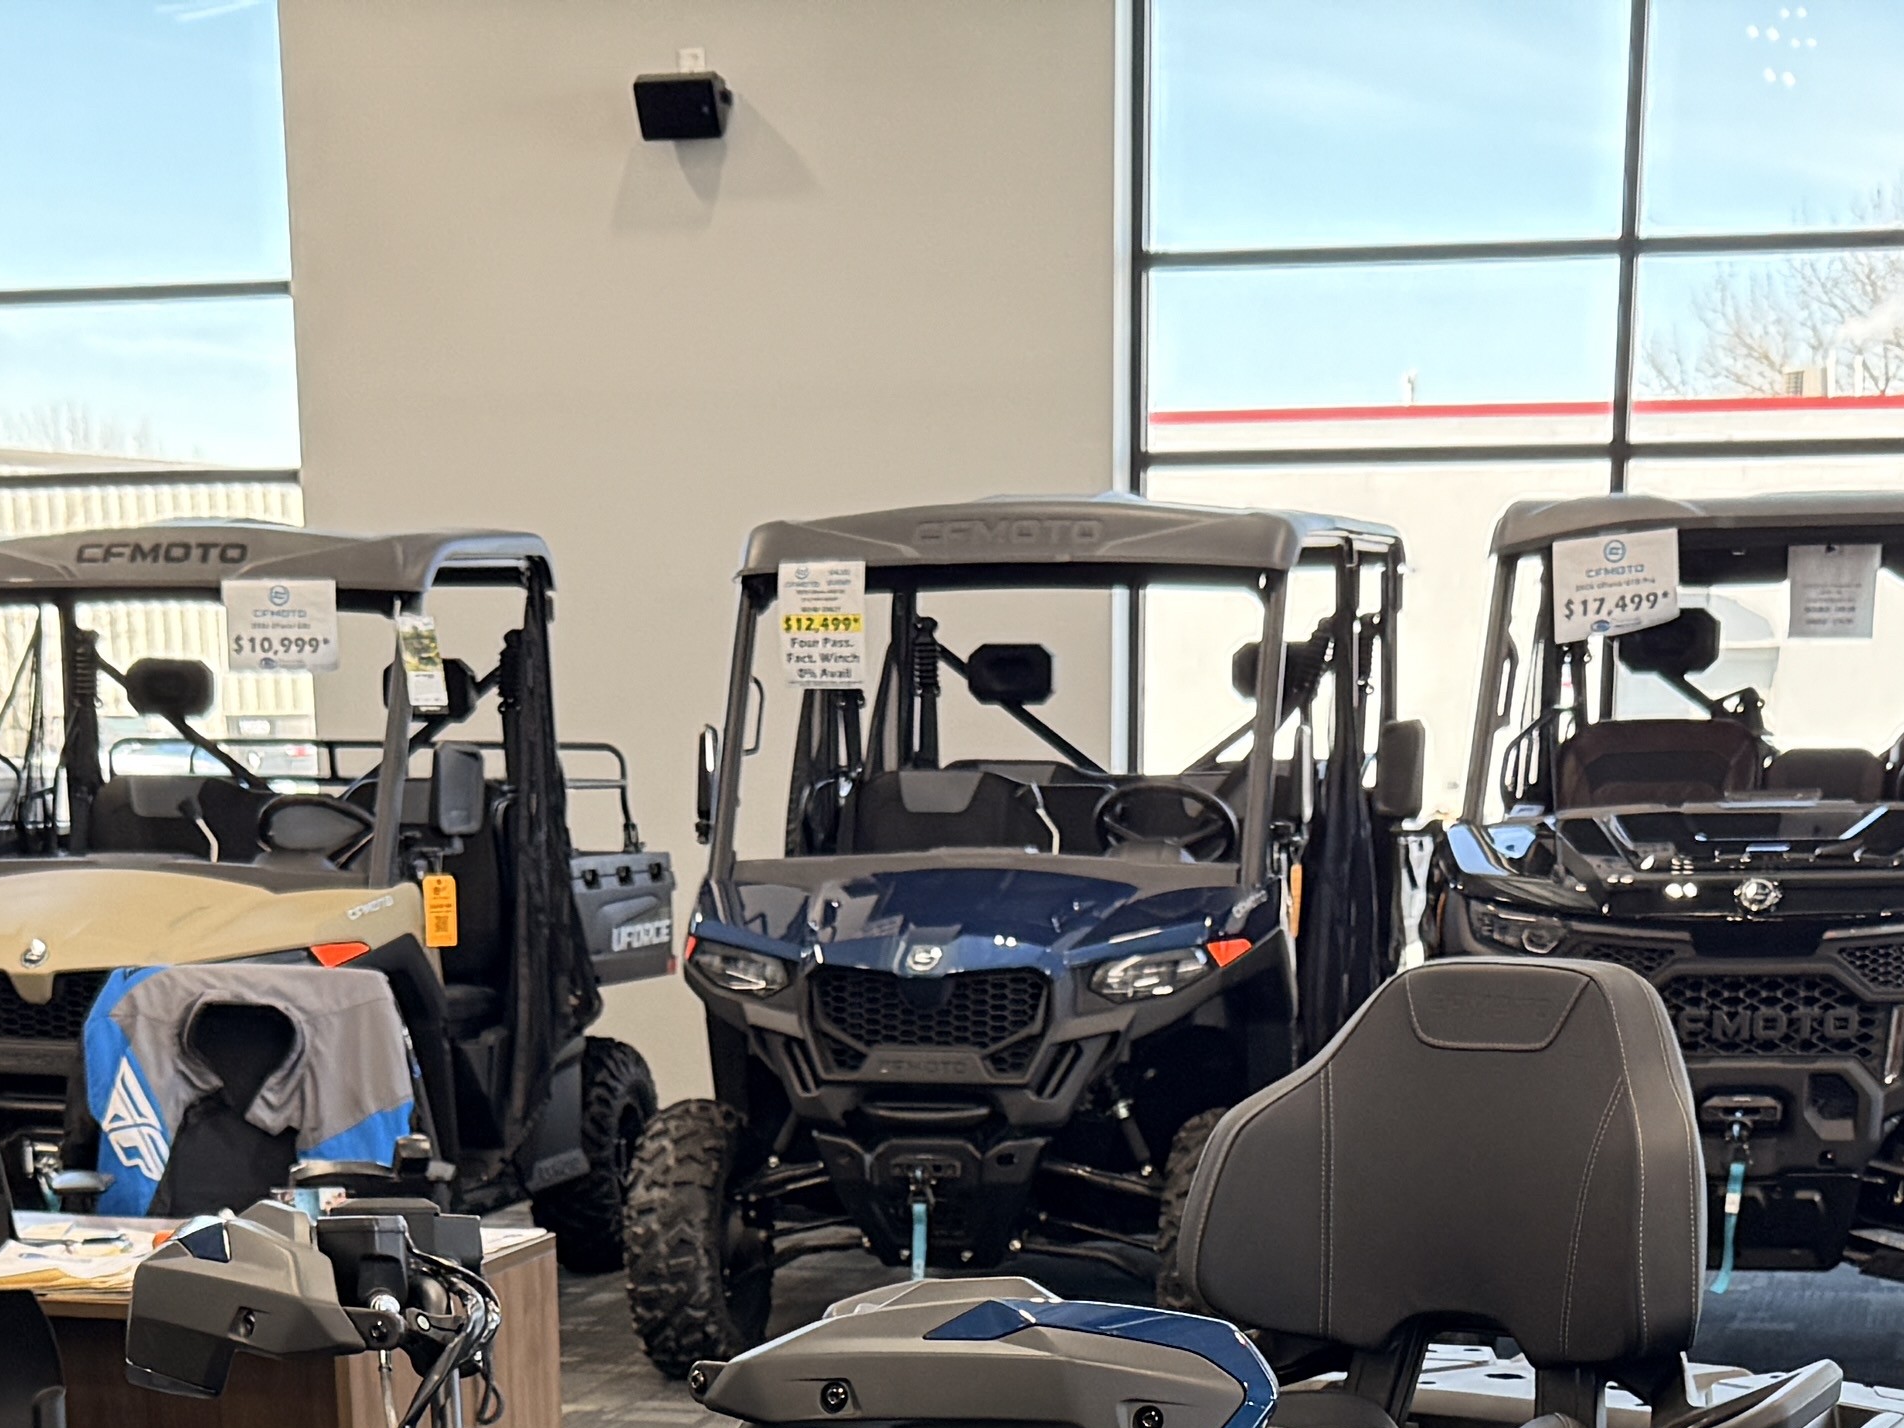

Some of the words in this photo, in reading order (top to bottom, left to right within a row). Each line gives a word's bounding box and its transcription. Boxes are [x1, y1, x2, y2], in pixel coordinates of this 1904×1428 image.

[77, 543, 248, 564] CFMOTO
[1585, 564, 1644, 577] CFMOTO
[1670, 1008, 1859, 1041] FMOTO
